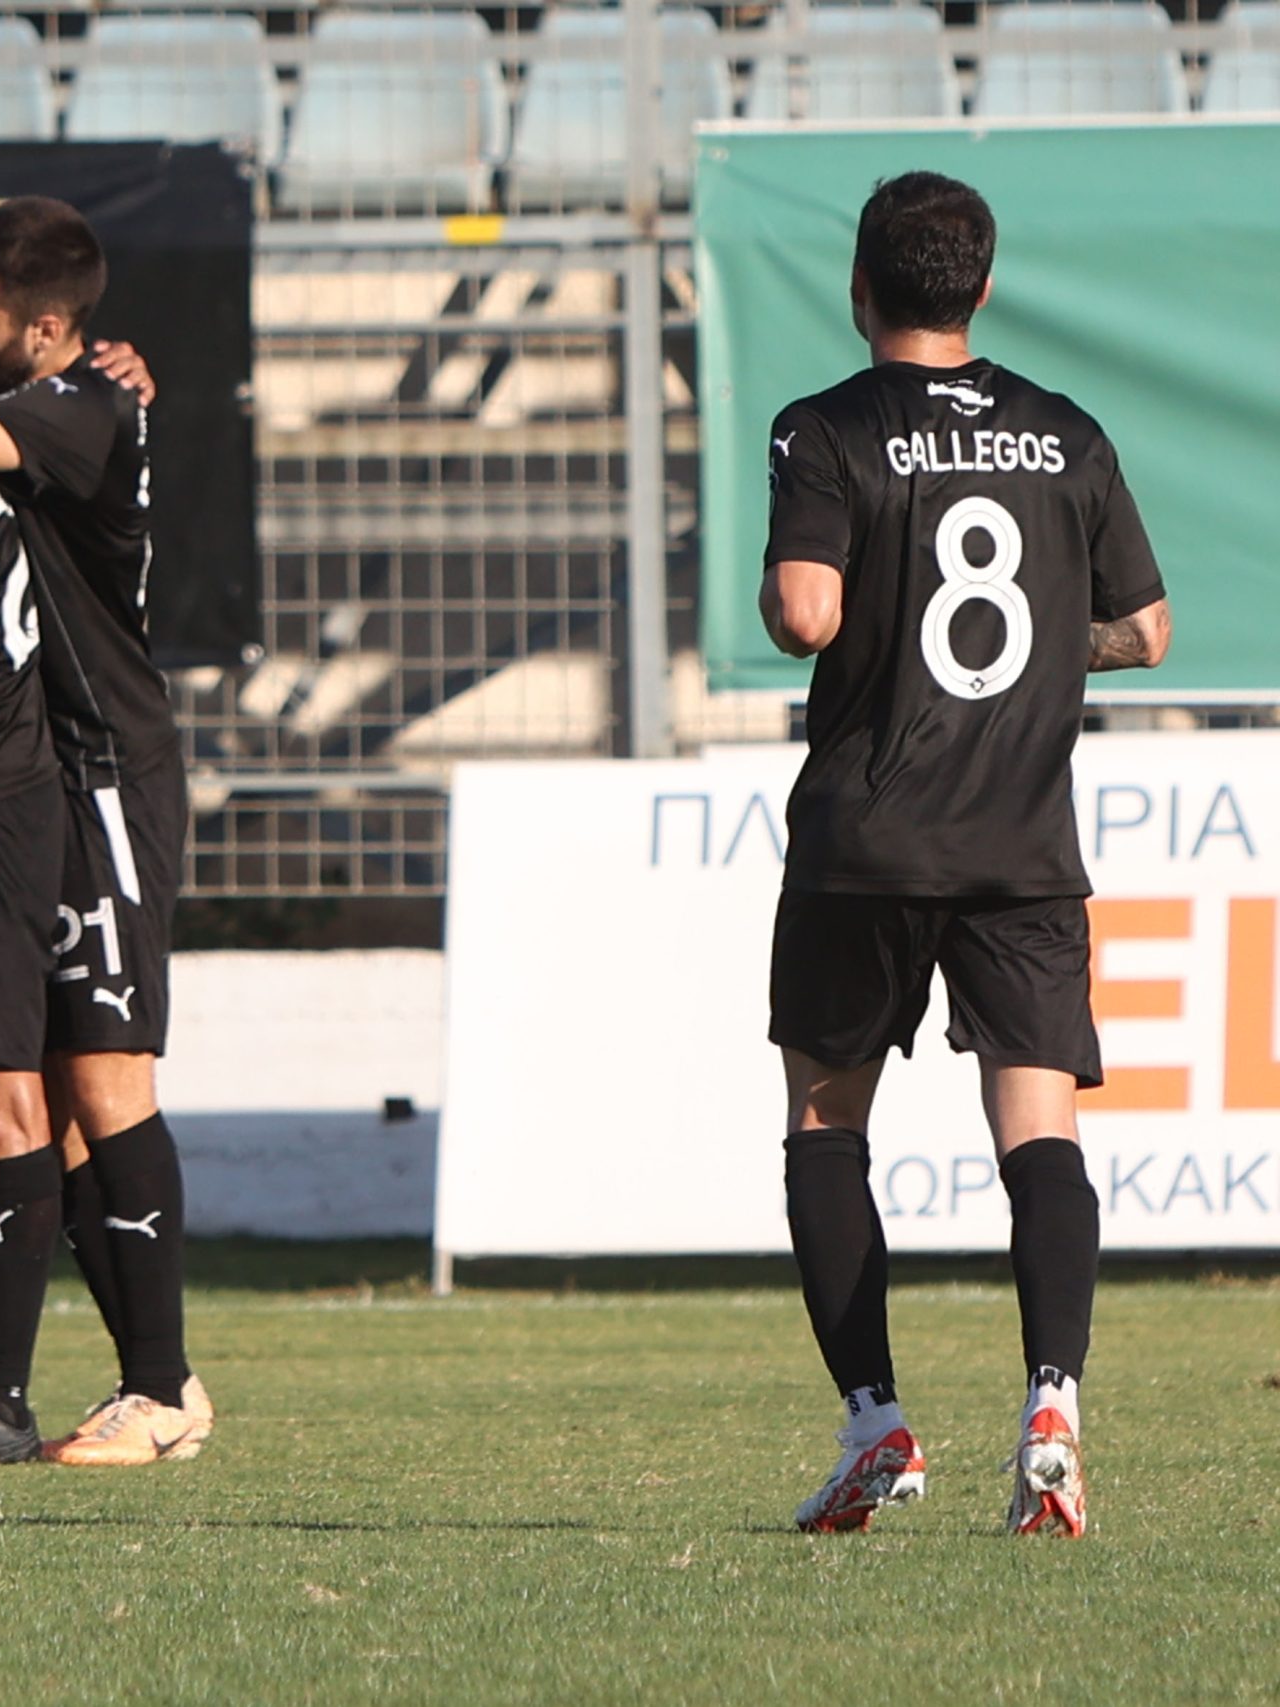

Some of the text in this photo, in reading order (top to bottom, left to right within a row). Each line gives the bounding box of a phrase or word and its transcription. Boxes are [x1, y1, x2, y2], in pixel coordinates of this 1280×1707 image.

[886, 430, 1066, 477] GALLEGOS
[921, 496, 1033, 700] 8
[51, 896, 122, 982] 21
[1108, 1153, 1280, 1218] ΚΑΚ
